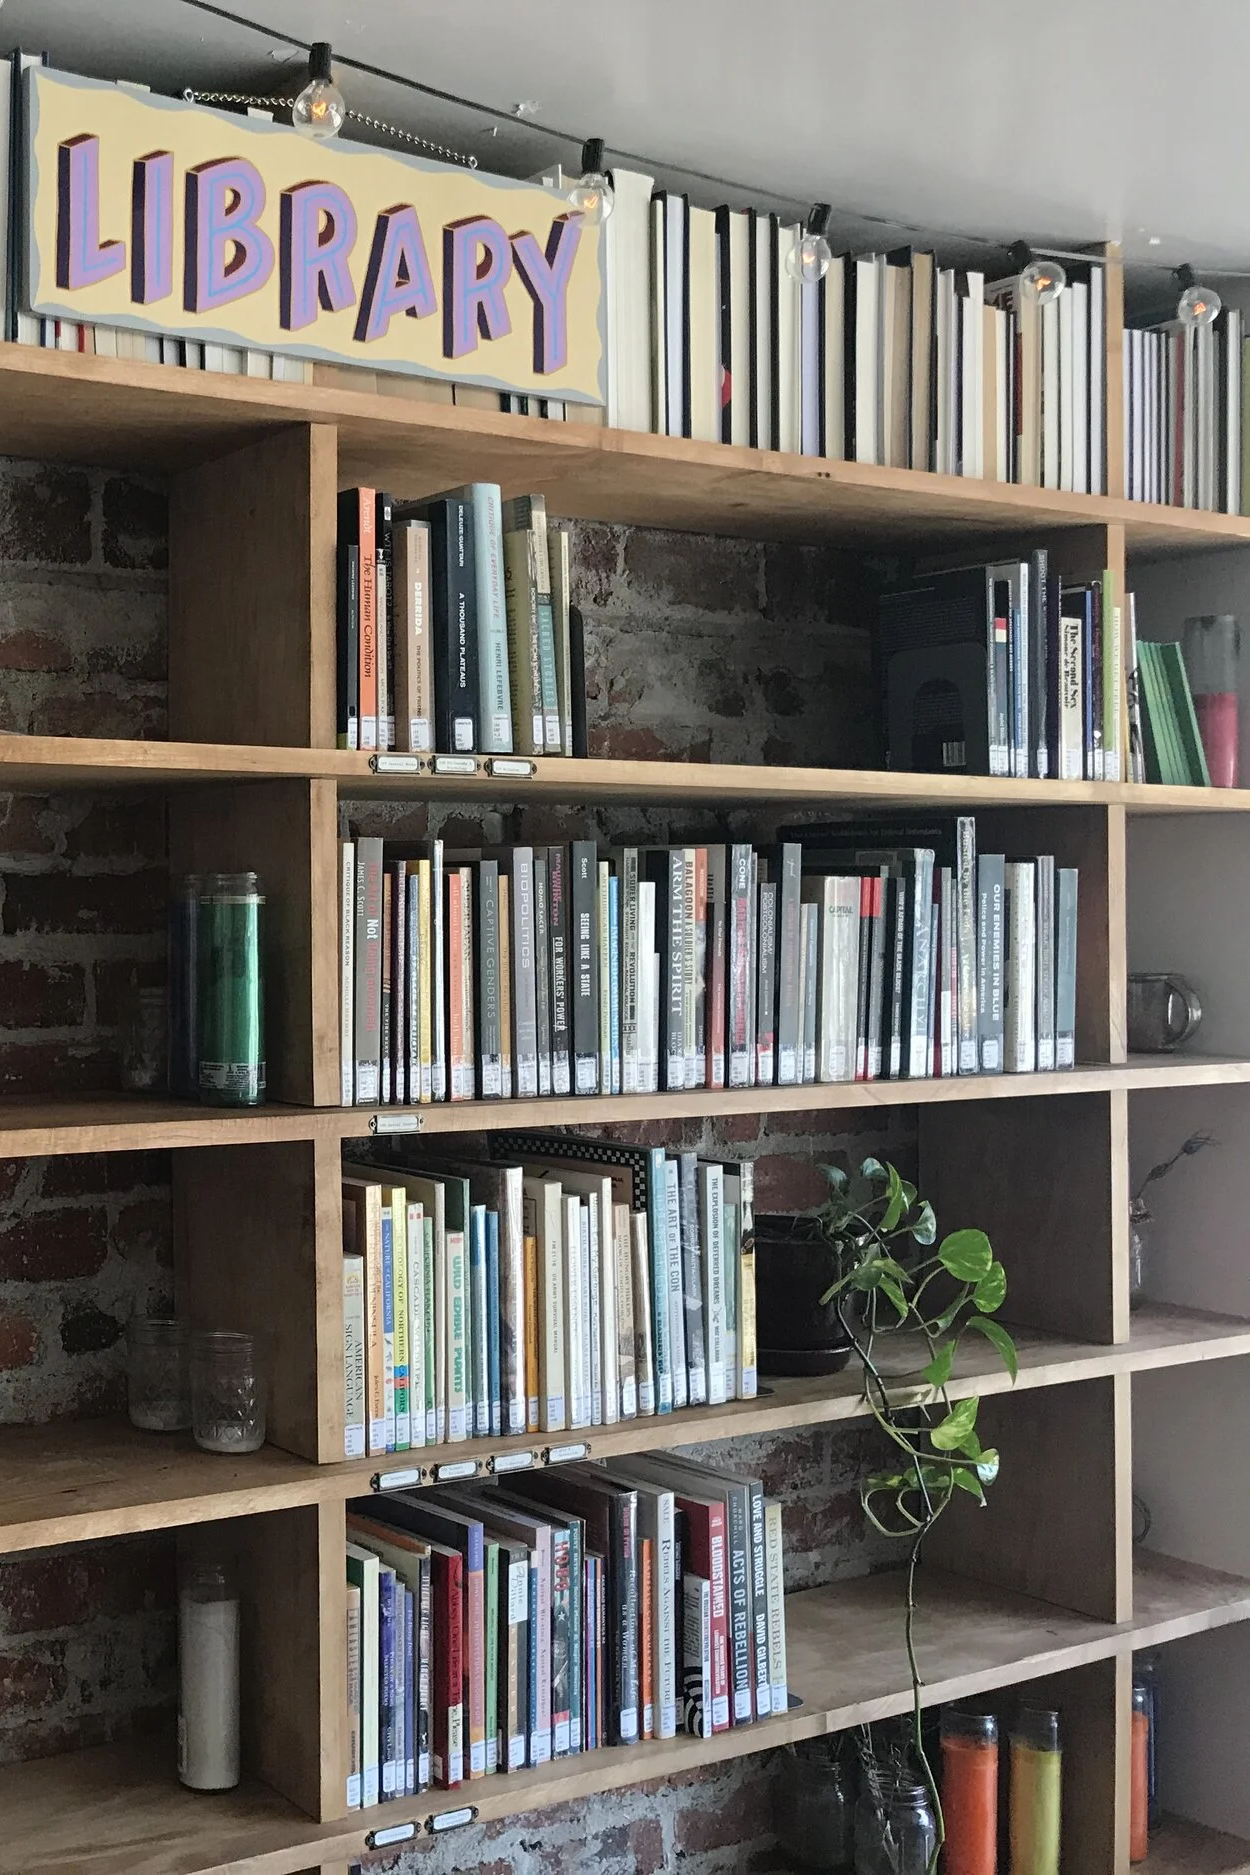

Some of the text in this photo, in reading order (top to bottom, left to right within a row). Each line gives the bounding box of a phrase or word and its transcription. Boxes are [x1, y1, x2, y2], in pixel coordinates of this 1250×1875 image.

[54, 132, 587, 376] LIBRARY
[364, 554, 376, 678] The Human Condition
[414, 582, 423, 636] DERRIDA
[459, 647, 467, 688] PLATEAUS
[581, 857, 589, 879] Scott
[738, 858, 747, 889] CONE
[367, 918, 379, 940] Not
[520, 863, 530, 969] BIOPOLITICS
[580, 912, 590, 940] SEEING
[580, 944, 590, 960] LIKE
[671, 856, 683, 1017] ARM THE SPIRIT
[992, 884, 1001, 1021] OUR ENEMIES IN BLUE
[486, 899, 496, 1019] CAPTIVE GENDERS
[580, 973, 590, 997] STATE
[711, 1177, 719, 1190] THE
[667, 1183, 680, 1293] THE ART OF THE CON
[712, 1230, 719, 1240] OF
[712, 1277, 720, 1305] DREAMS
[345, 1324, 354, 1417] SIGN LANGUAGE
[354, 1339, 363, 1401] AMERICAN
[711, 1534, 725, 1619] BLOODSTAINED
[752, 1494, 766, 1597] LOVE AND STRUGGLE
[732, 1550, 749, 1690] ACTS OF REBELLION
[768, 1517, 782, 1670] RED STATE REBELS
